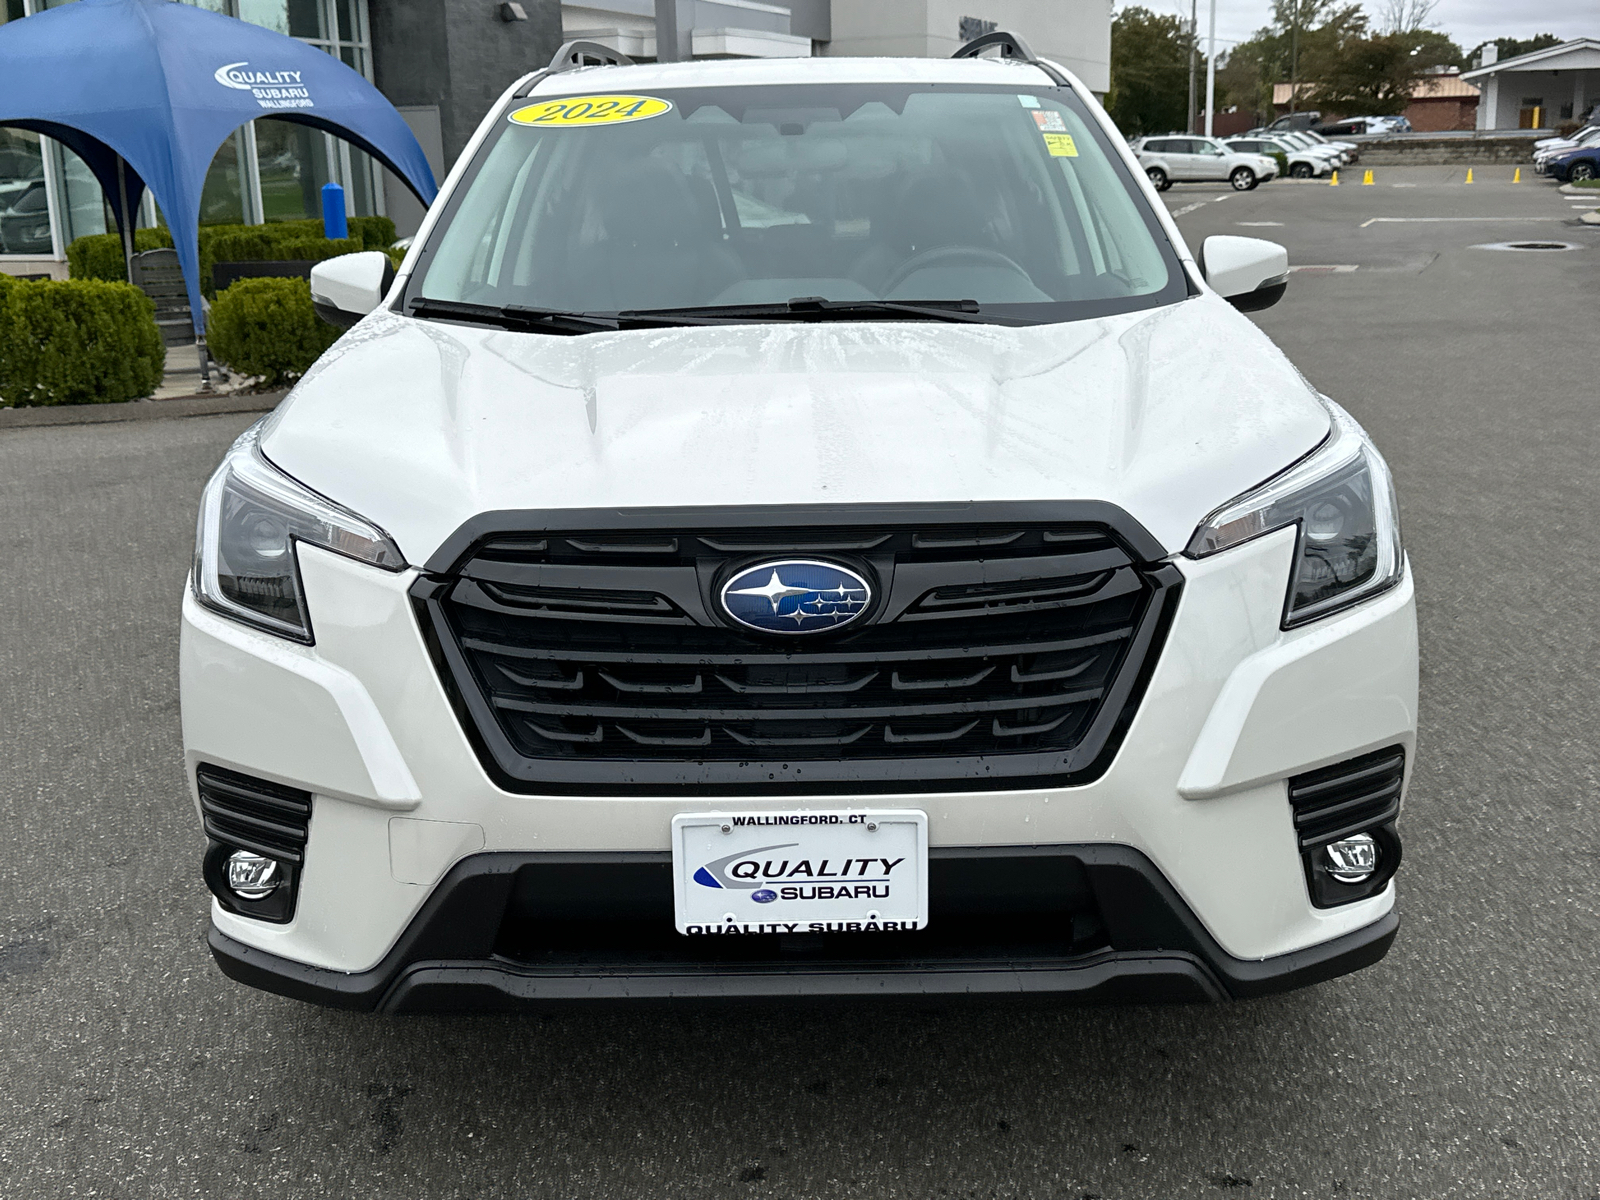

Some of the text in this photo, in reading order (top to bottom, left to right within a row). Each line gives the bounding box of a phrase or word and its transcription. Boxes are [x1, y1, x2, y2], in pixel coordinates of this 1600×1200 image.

[228, 71, 301, 83] QUALITY
[252, 87, 309, 99] SUBARU
[532, 100, 647, 122] 2024
[732, 814, 867, 826] WALLINGFORD, CT
[731, 857, 906, 880] QUALITY
[780, 885, 890, 901] SUBARU
[685, 921, 918, 936] QUALITY SUBARU
